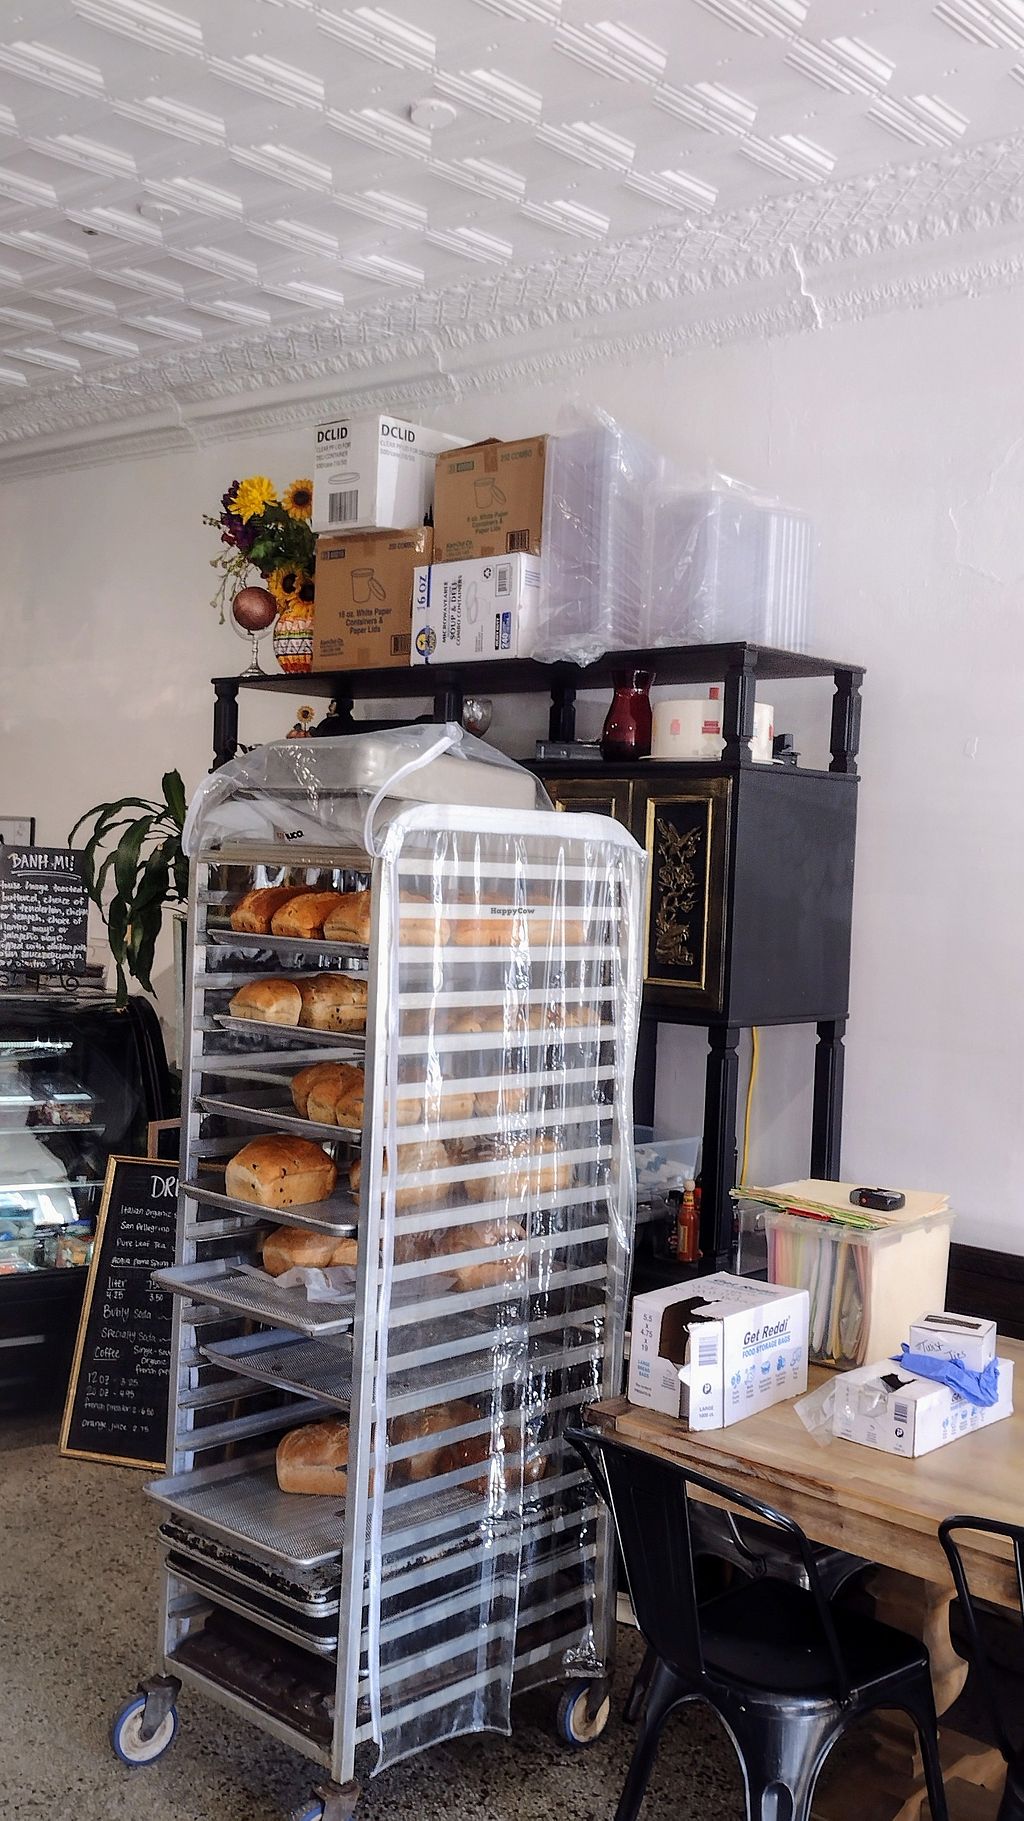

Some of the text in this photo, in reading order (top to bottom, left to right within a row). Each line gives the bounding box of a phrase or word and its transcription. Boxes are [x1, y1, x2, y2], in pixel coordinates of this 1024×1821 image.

[317, 427, 348, 443] DCLID
[381, 424, 415, 442] DCLID
[418, 574, 427, 593] OZ
[357, 608, 373, 616] White
[374, 607, 392, 616] Paper
[346, 617, 377, 627] Containers
[350, 625, 381, 635] Paper Lids
[7, 852, 49, 870] BANH
[53, 884, 83, 893] toasted
[43, 895, 70, 905] choice
[73, 897, 85, 905] of
[48, 915, 70, 925] choice
[73, 917, 83, 925] of
[32, 925, 55, 936] mayo
[151, 1175, 179, 1198] DRI
[121, 1205, 144, 1214] Italian
[120, 1221, 170, 1233] San Pellegrino
[116, 1238, 166, 1249] Pure Leaf Tea
[103, 1304, 152, 1322] Bubly Soda
[643, 1313, 653, 1322] 5.5
[138, 1331, 157, 1342] Soda
[640, 1329, 653, 1339] 4.75
[743, 1319, 788, 1345] Get Reddi
[742, 1335, 791, 1358] FOOD STORAGE BAGS
[94, 1346, 120, 1359] Coffee
[88, 1371, 98, 1383] 12
